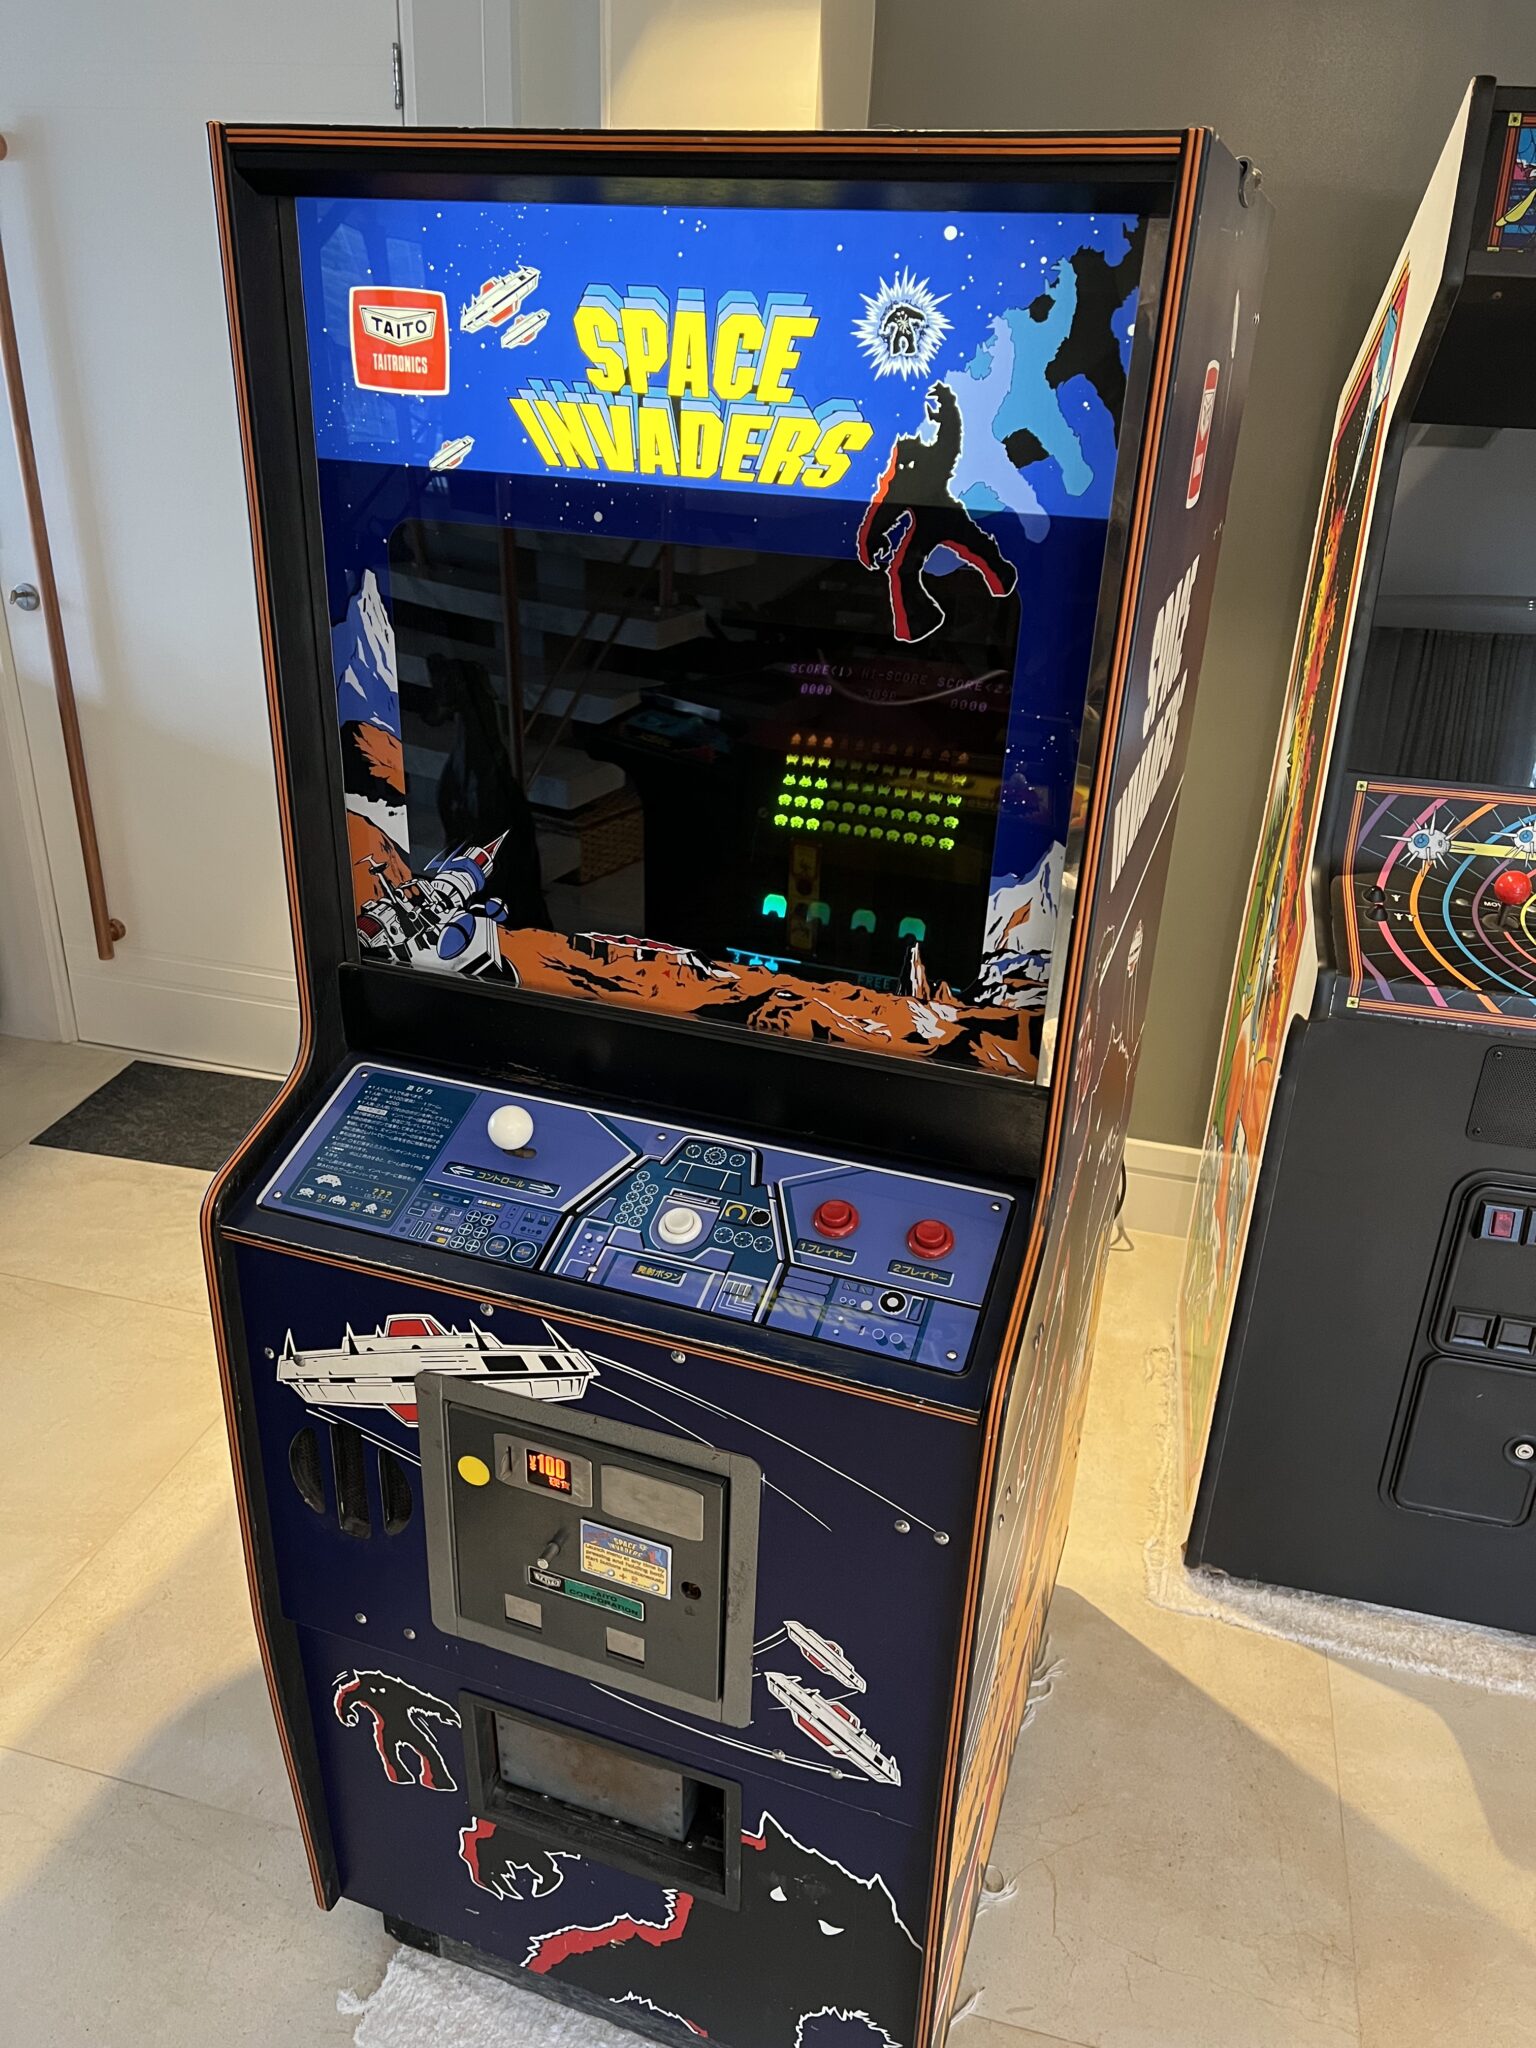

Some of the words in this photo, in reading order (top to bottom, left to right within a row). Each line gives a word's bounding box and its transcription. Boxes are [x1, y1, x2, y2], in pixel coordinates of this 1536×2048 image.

[371, 316, 427, 339] TAITO
[573, 302, 818, 404] SPACE
[373, 353, 428, 375] TAITRONICS
[509, 396, 874, 488] INVADERS
[800, 683, 833, 696] 0000
[950, 699, 988, 713] 0000
[733, 952, 740, 964] 3
[857, 974, 891, 990] FREE
[477, 1171, 525, 1188] コントロール
[800, 1242, 852, 1259] 1プレイヤー
[892, 1263, 948, 1281] 2プレイヤー
[529, 1453, 566, 1480] ¥100
[613, 1537, 637, 1550] SPACE
[585, 1550, 611, 1562] pressing
[612, 1558, 624, 1566] and
[625, 1560, 648, 1574] holding
[585, 1555, 599, 1564] start
[599, 1559, 621, 1570] buttons
[606, 1551, 622, 1560] menu
[642, 1561, 656, 1571] time
[569, 1588, 638, 1616] CORPORATION
[591, 1591, 618, 1602] AITO
